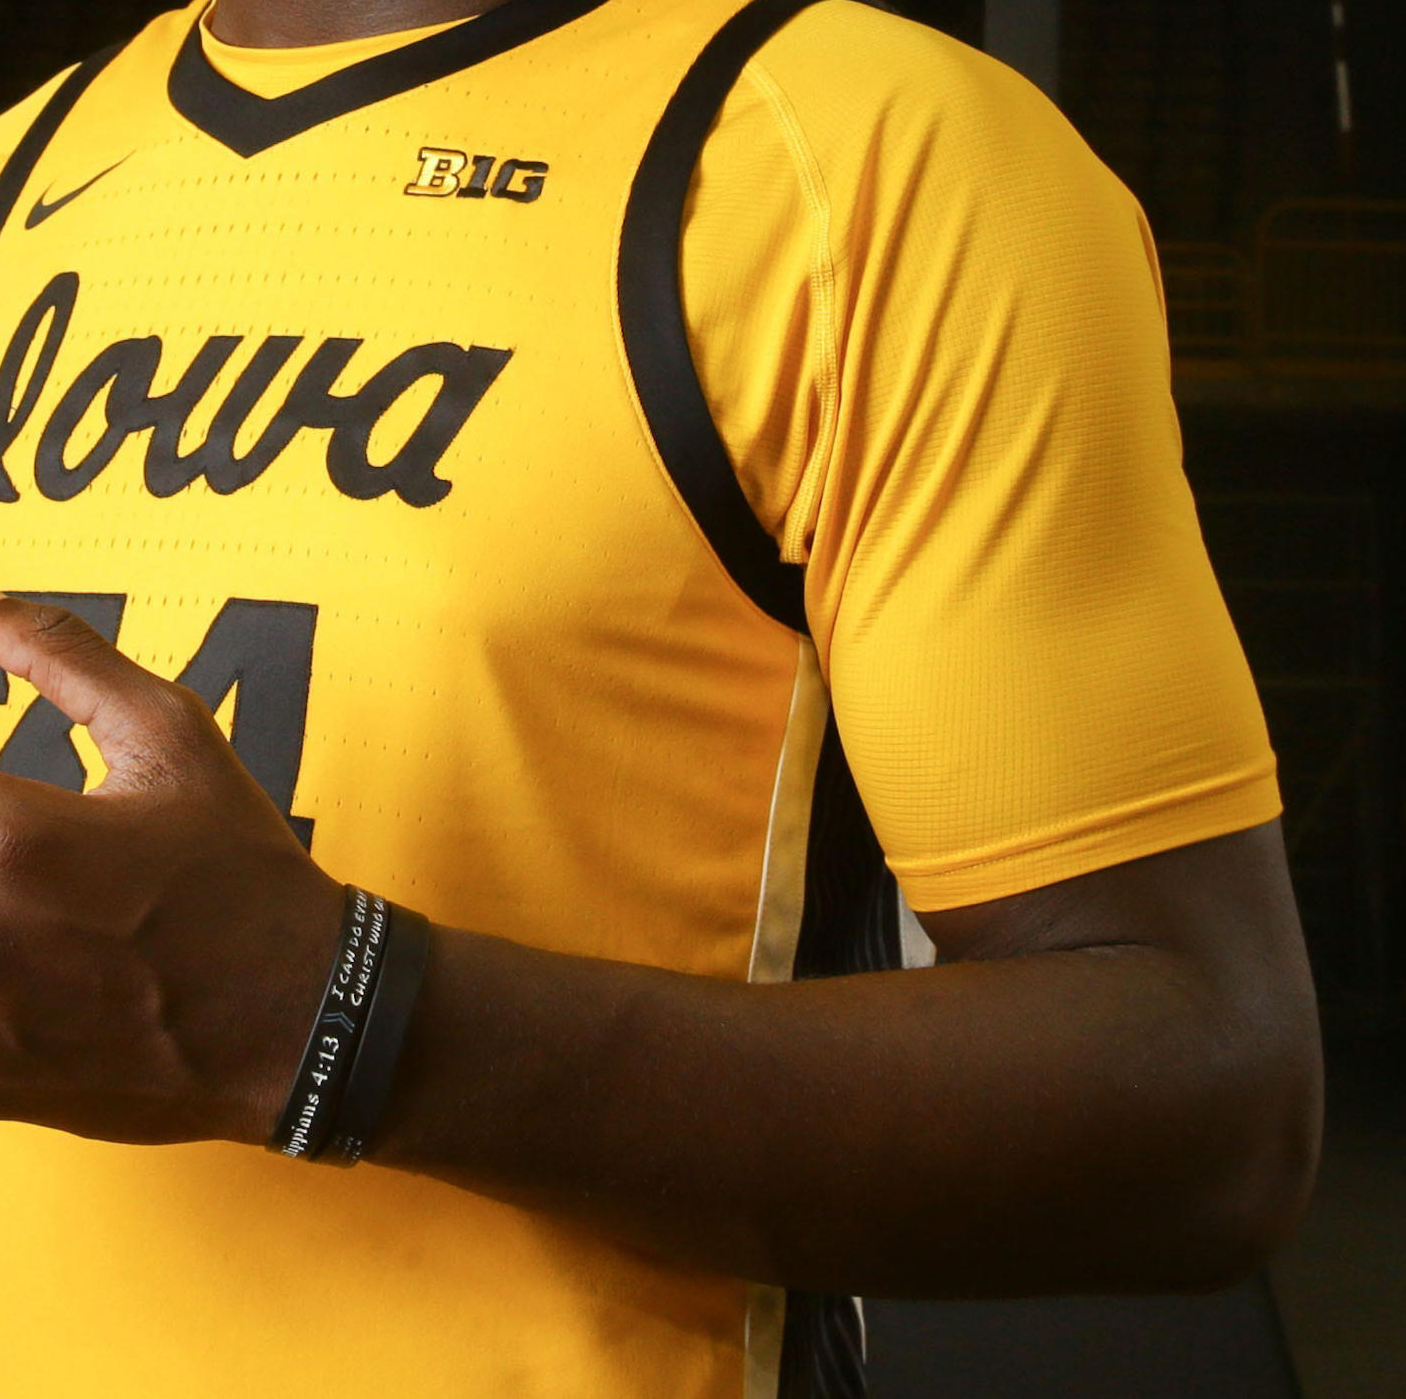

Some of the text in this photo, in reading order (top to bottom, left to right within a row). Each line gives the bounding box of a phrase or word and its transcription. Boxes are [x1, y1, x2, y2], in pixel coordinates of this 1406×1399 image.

[330, 983, 344, 1002] I
[340, 948, 356, 985] CAN
[349, 926, 363, 948] DO
[351, 944, 374, 1007] CHRIST
[368, 913, 384, 945] WHO
[311, 1035, 341, 1086] 4:13
